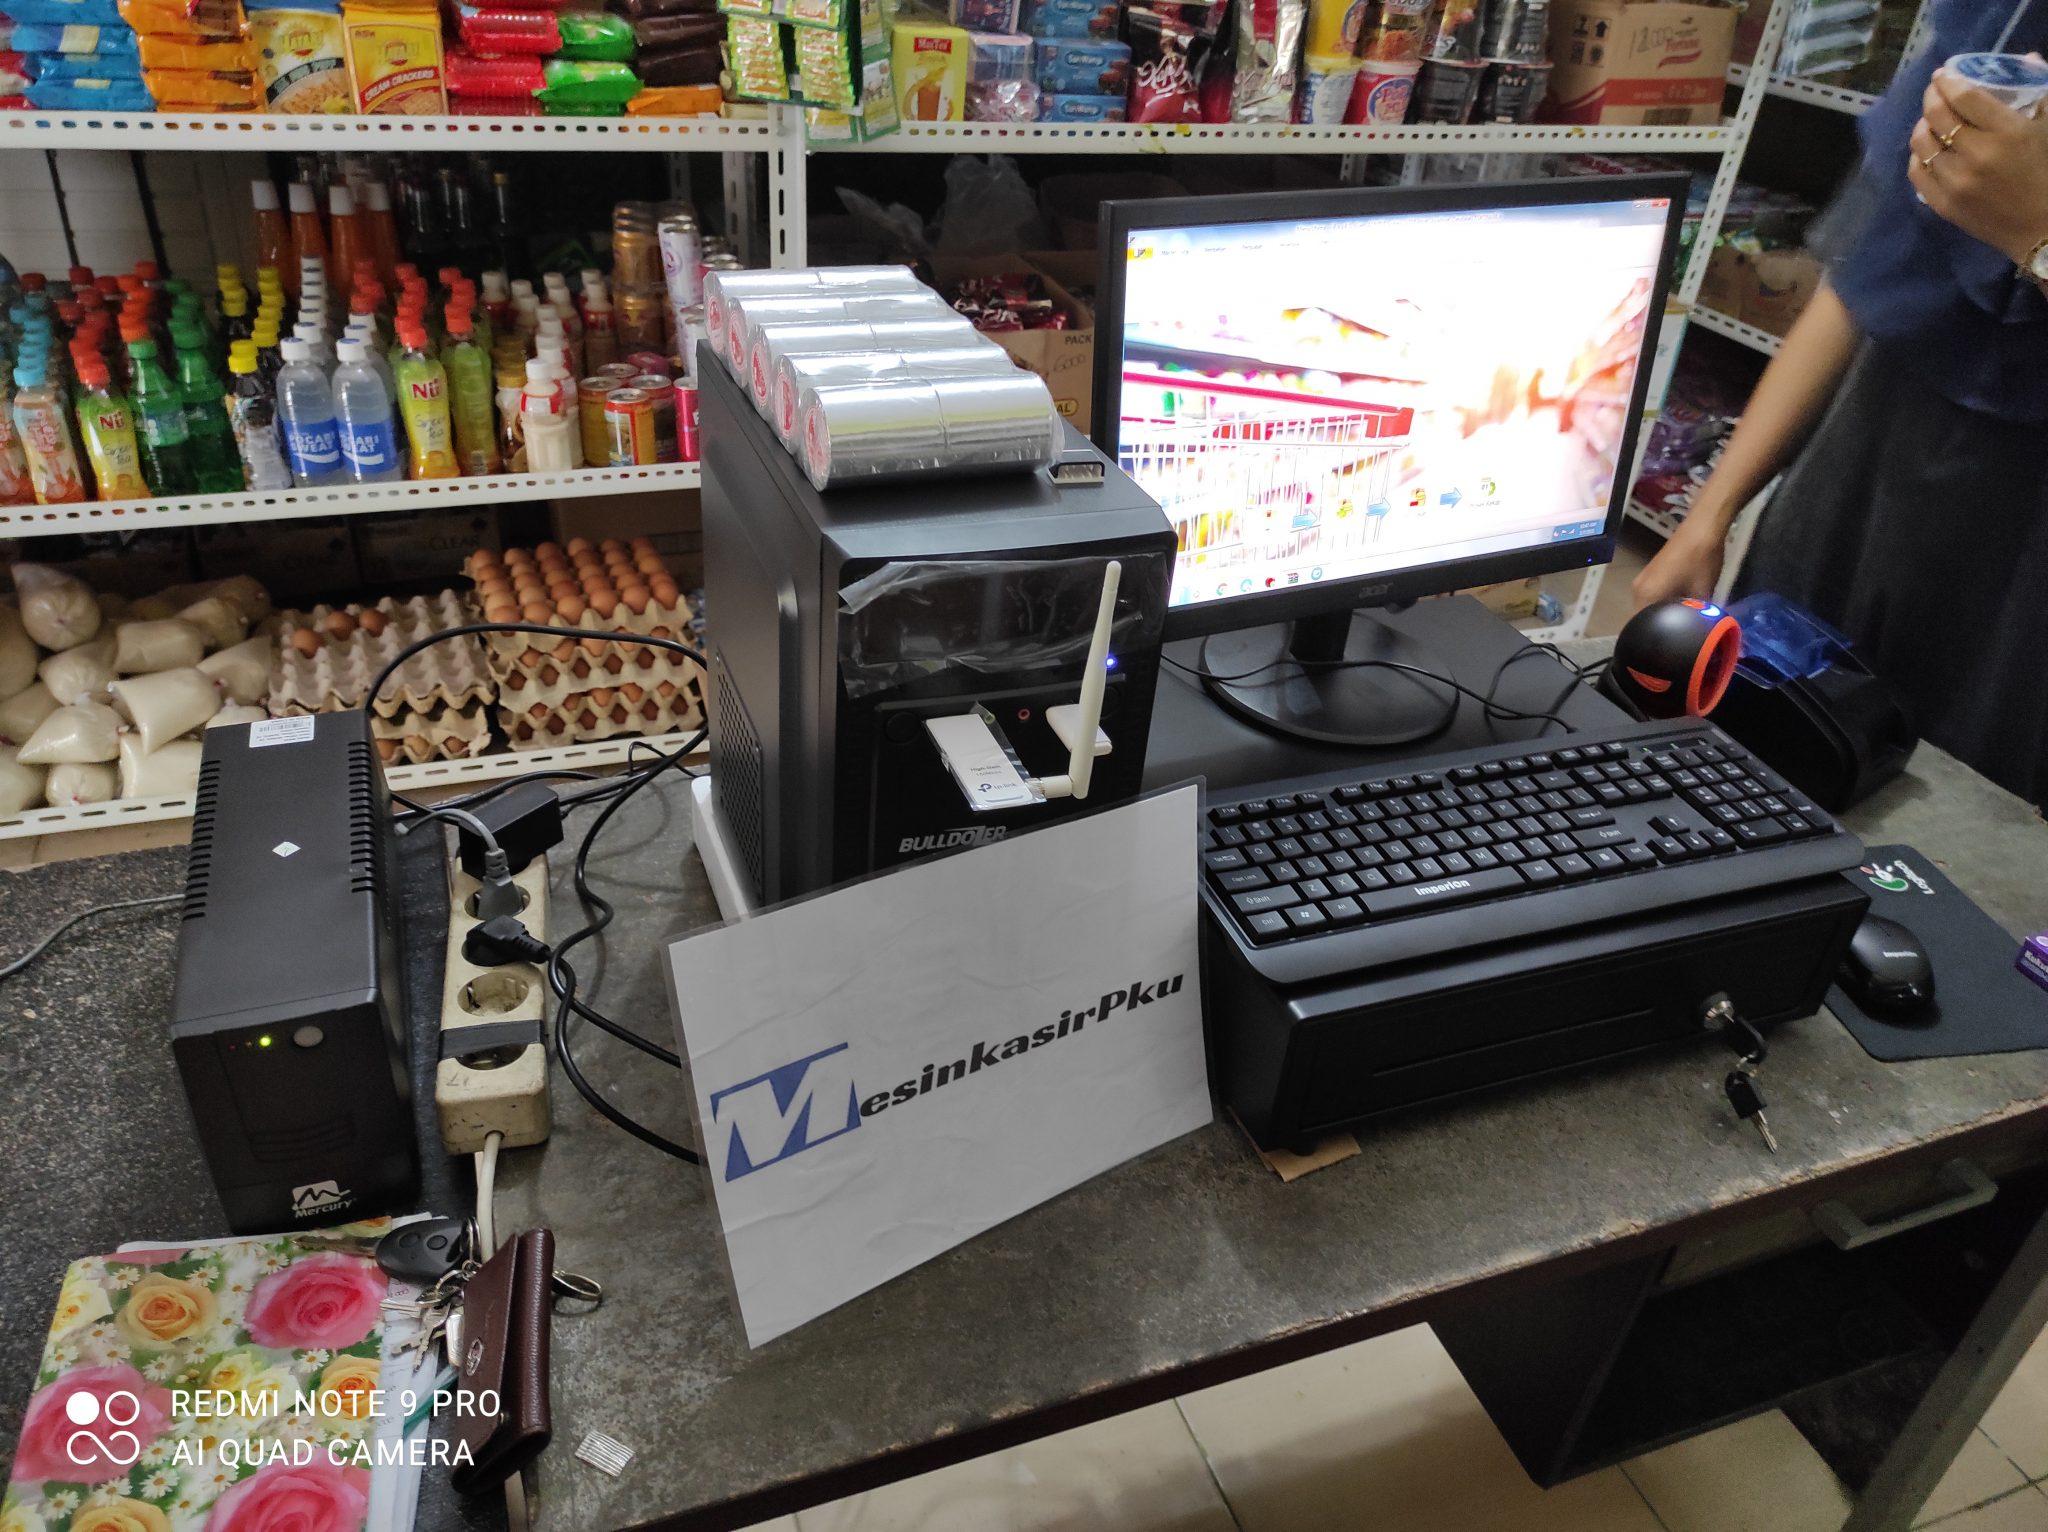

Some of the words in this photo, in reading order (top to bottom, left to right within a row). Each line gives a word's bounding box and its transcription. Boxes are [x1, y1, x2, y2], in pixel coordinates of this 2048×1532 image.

[898, 825, 1007, 853] BULLDOZER
[710, 973, 1184, 1182] MesinkasirPku
[294, 1199, 353, 1219] Mercury
